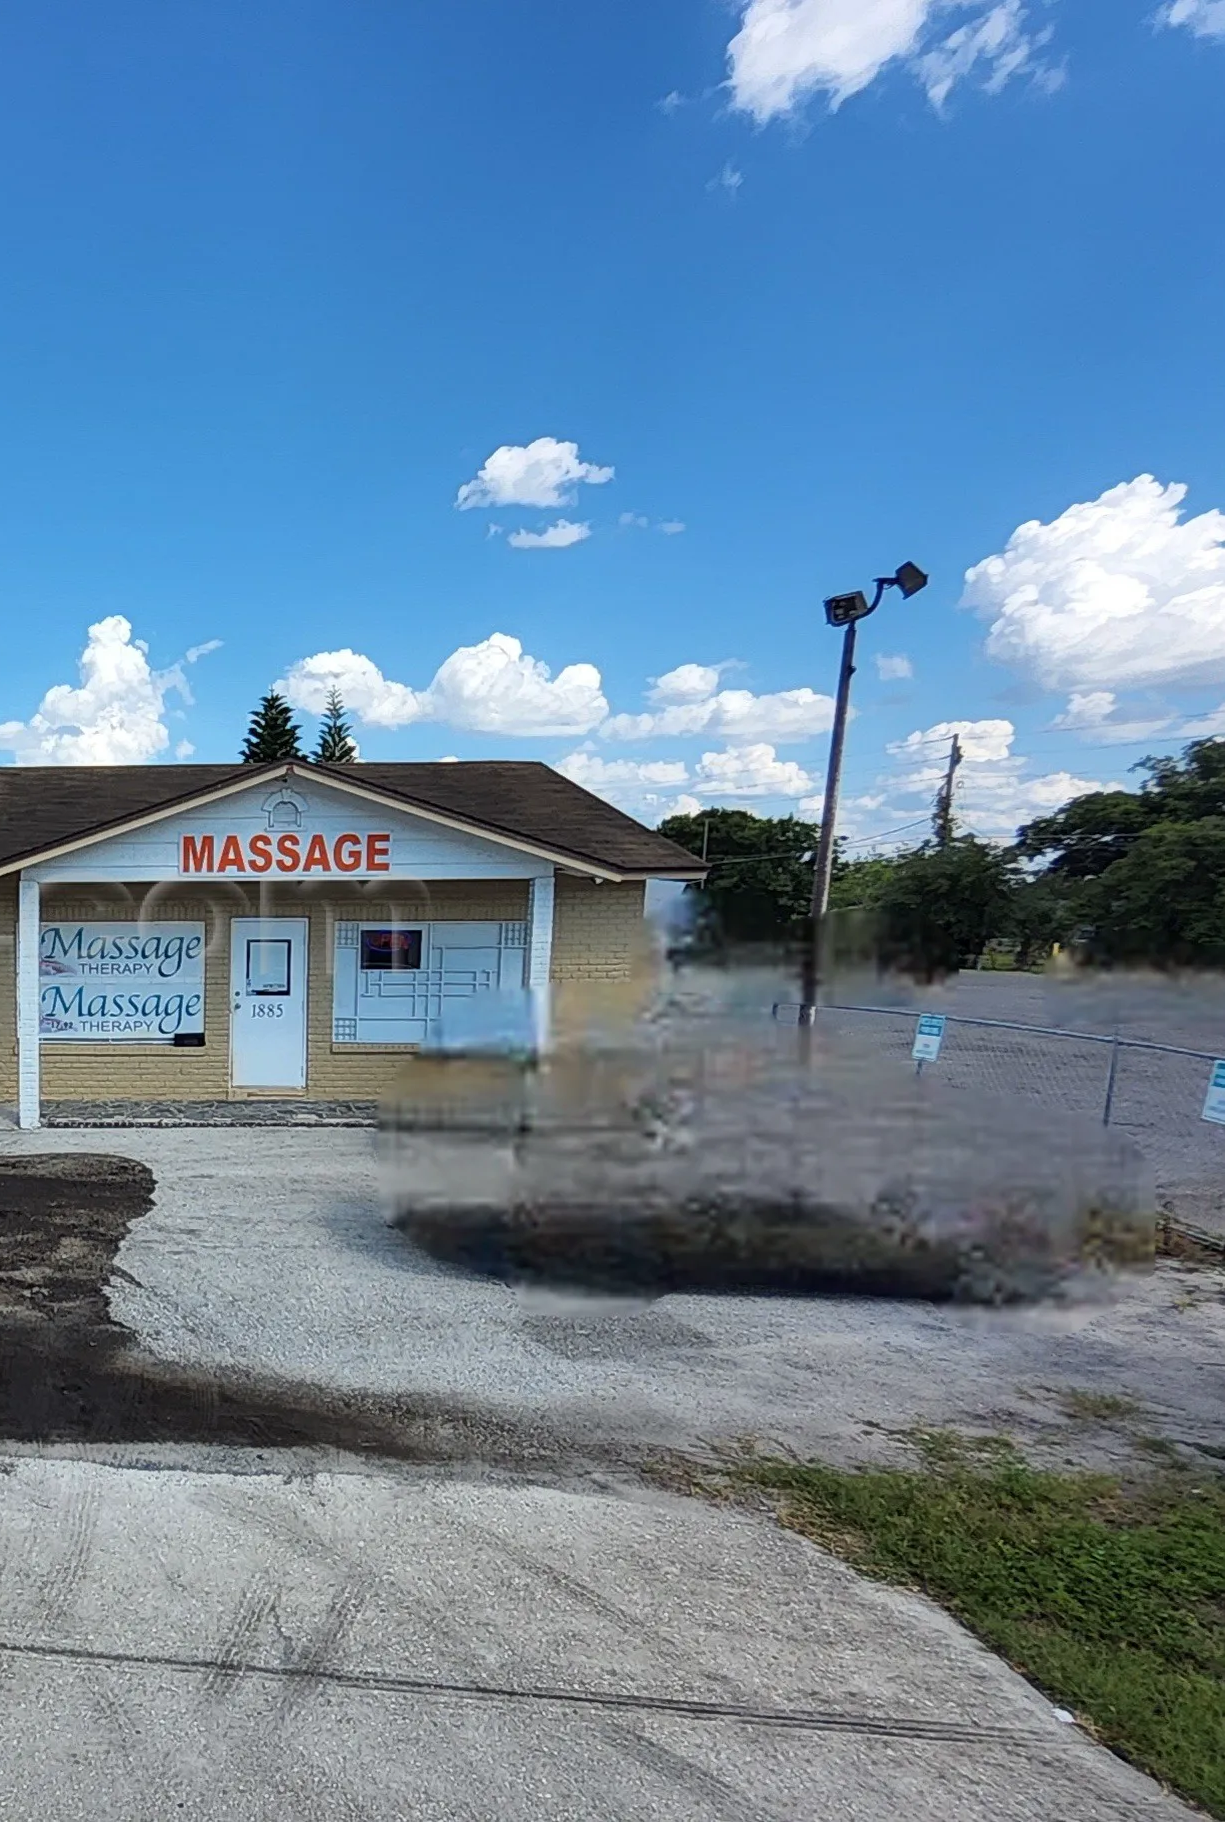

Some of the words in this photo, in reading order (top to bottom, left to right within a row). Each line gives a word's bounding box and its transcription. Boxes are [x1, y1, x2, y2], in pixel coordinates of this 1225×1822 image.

[182, 833, 391, 873] MASSAGE
[40, 926, 202, 978] Massage
[78, 963, 154, 975] THERAPY
[41, 985, 202, 1035] Massage
[250, 1003, 284, 1019] 1885
[78, 1021, 154, 1032] THERAPY
